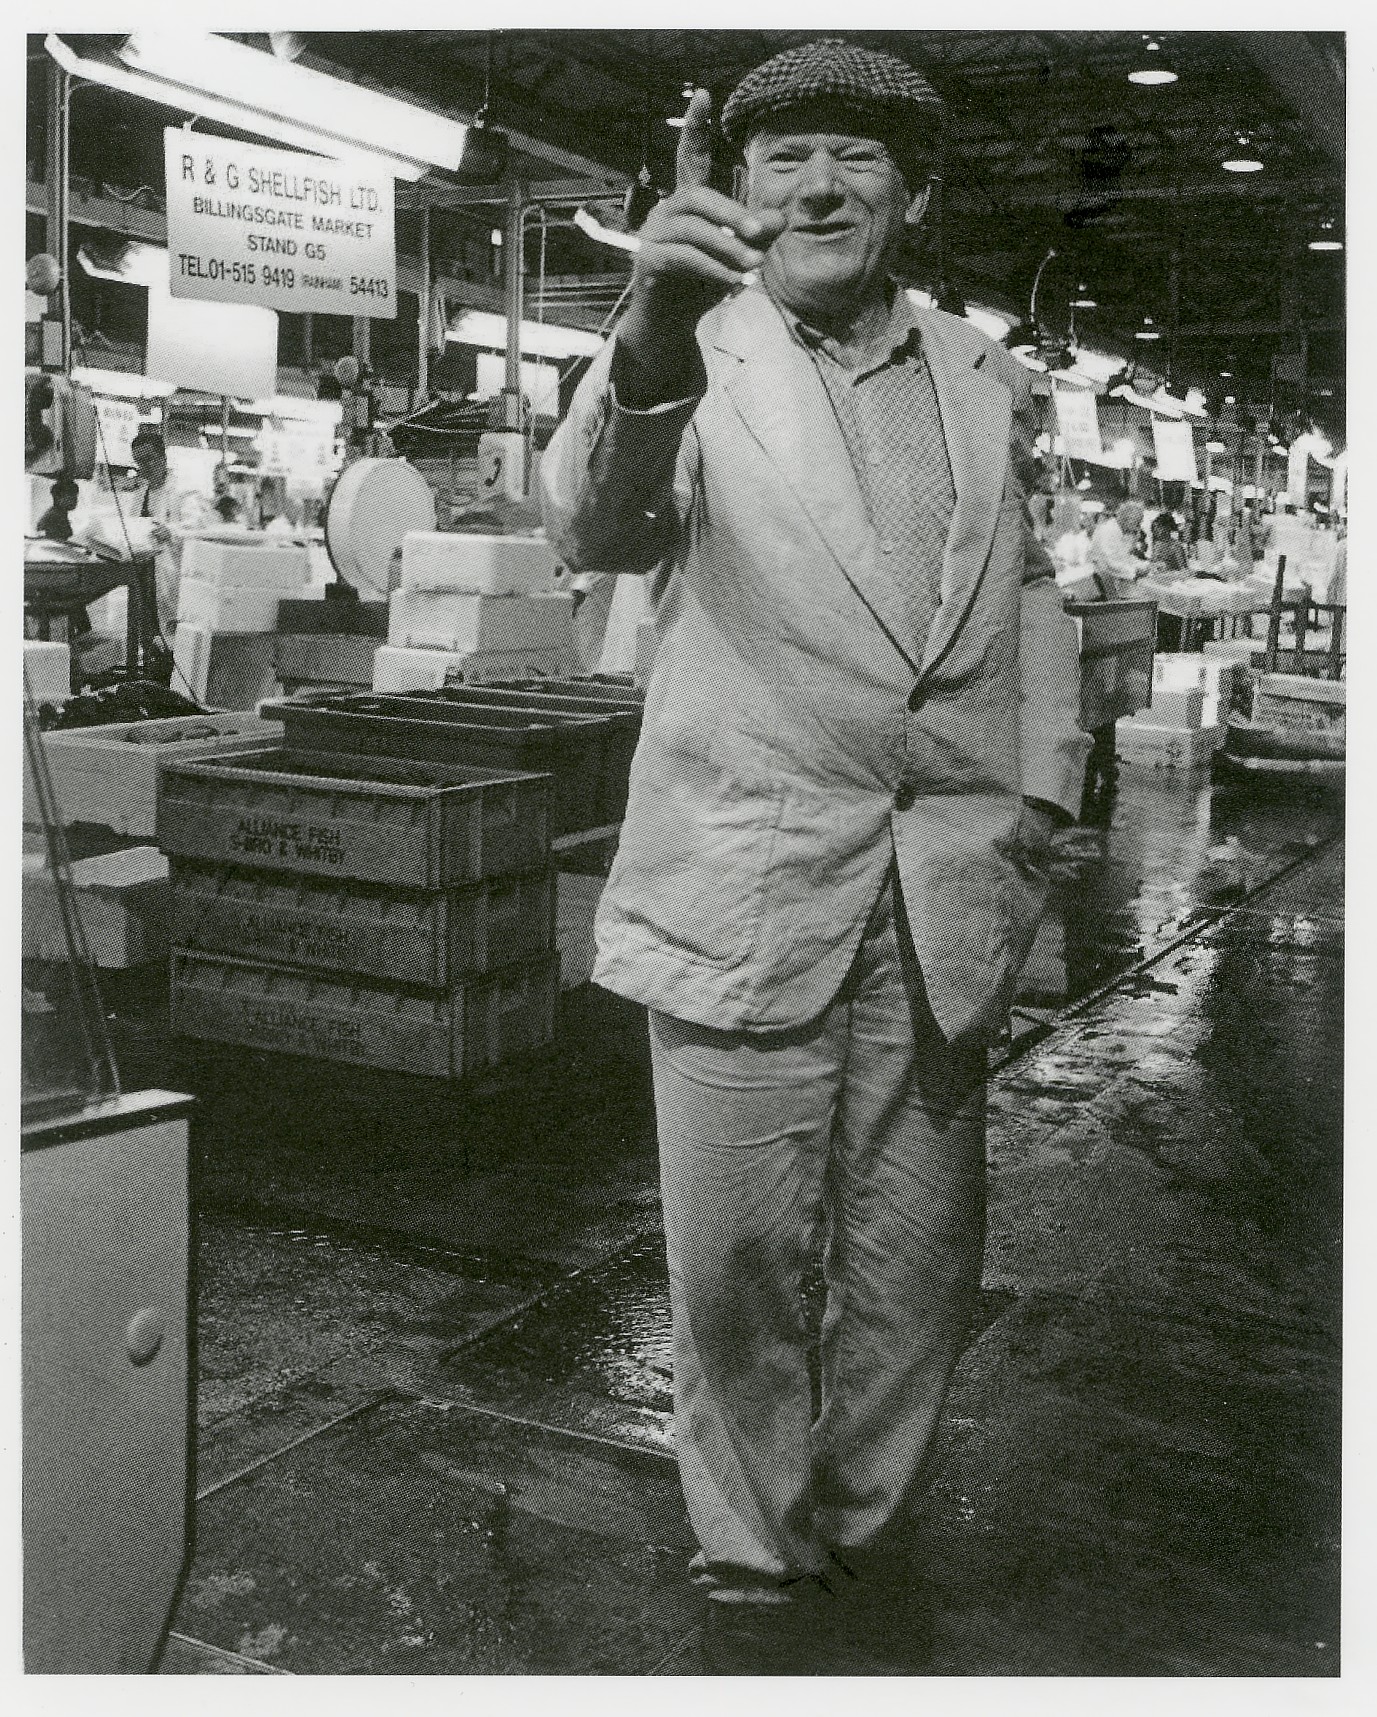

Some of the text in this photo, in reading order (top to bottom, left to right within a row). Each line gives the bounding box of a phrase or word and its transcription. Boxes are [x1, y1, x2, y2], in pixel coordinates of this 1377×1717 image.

[182, 154, 195, 182] R
[204, 158, 216, 185] &
[226, 163, 240, 190] G
[249, 167, 342, 206] SHELLFISH
[193, 196, 374, 239] BILLINGSGATE MARKET
[247, 234, 327, 261] STAND G5
[262, 264, 296, 289] 9419
[350, 275, 389, 299] 54413
[237, 818, 341, 846] ALLIANCE FISH
[295, 843, 346, 865] WHITBY
